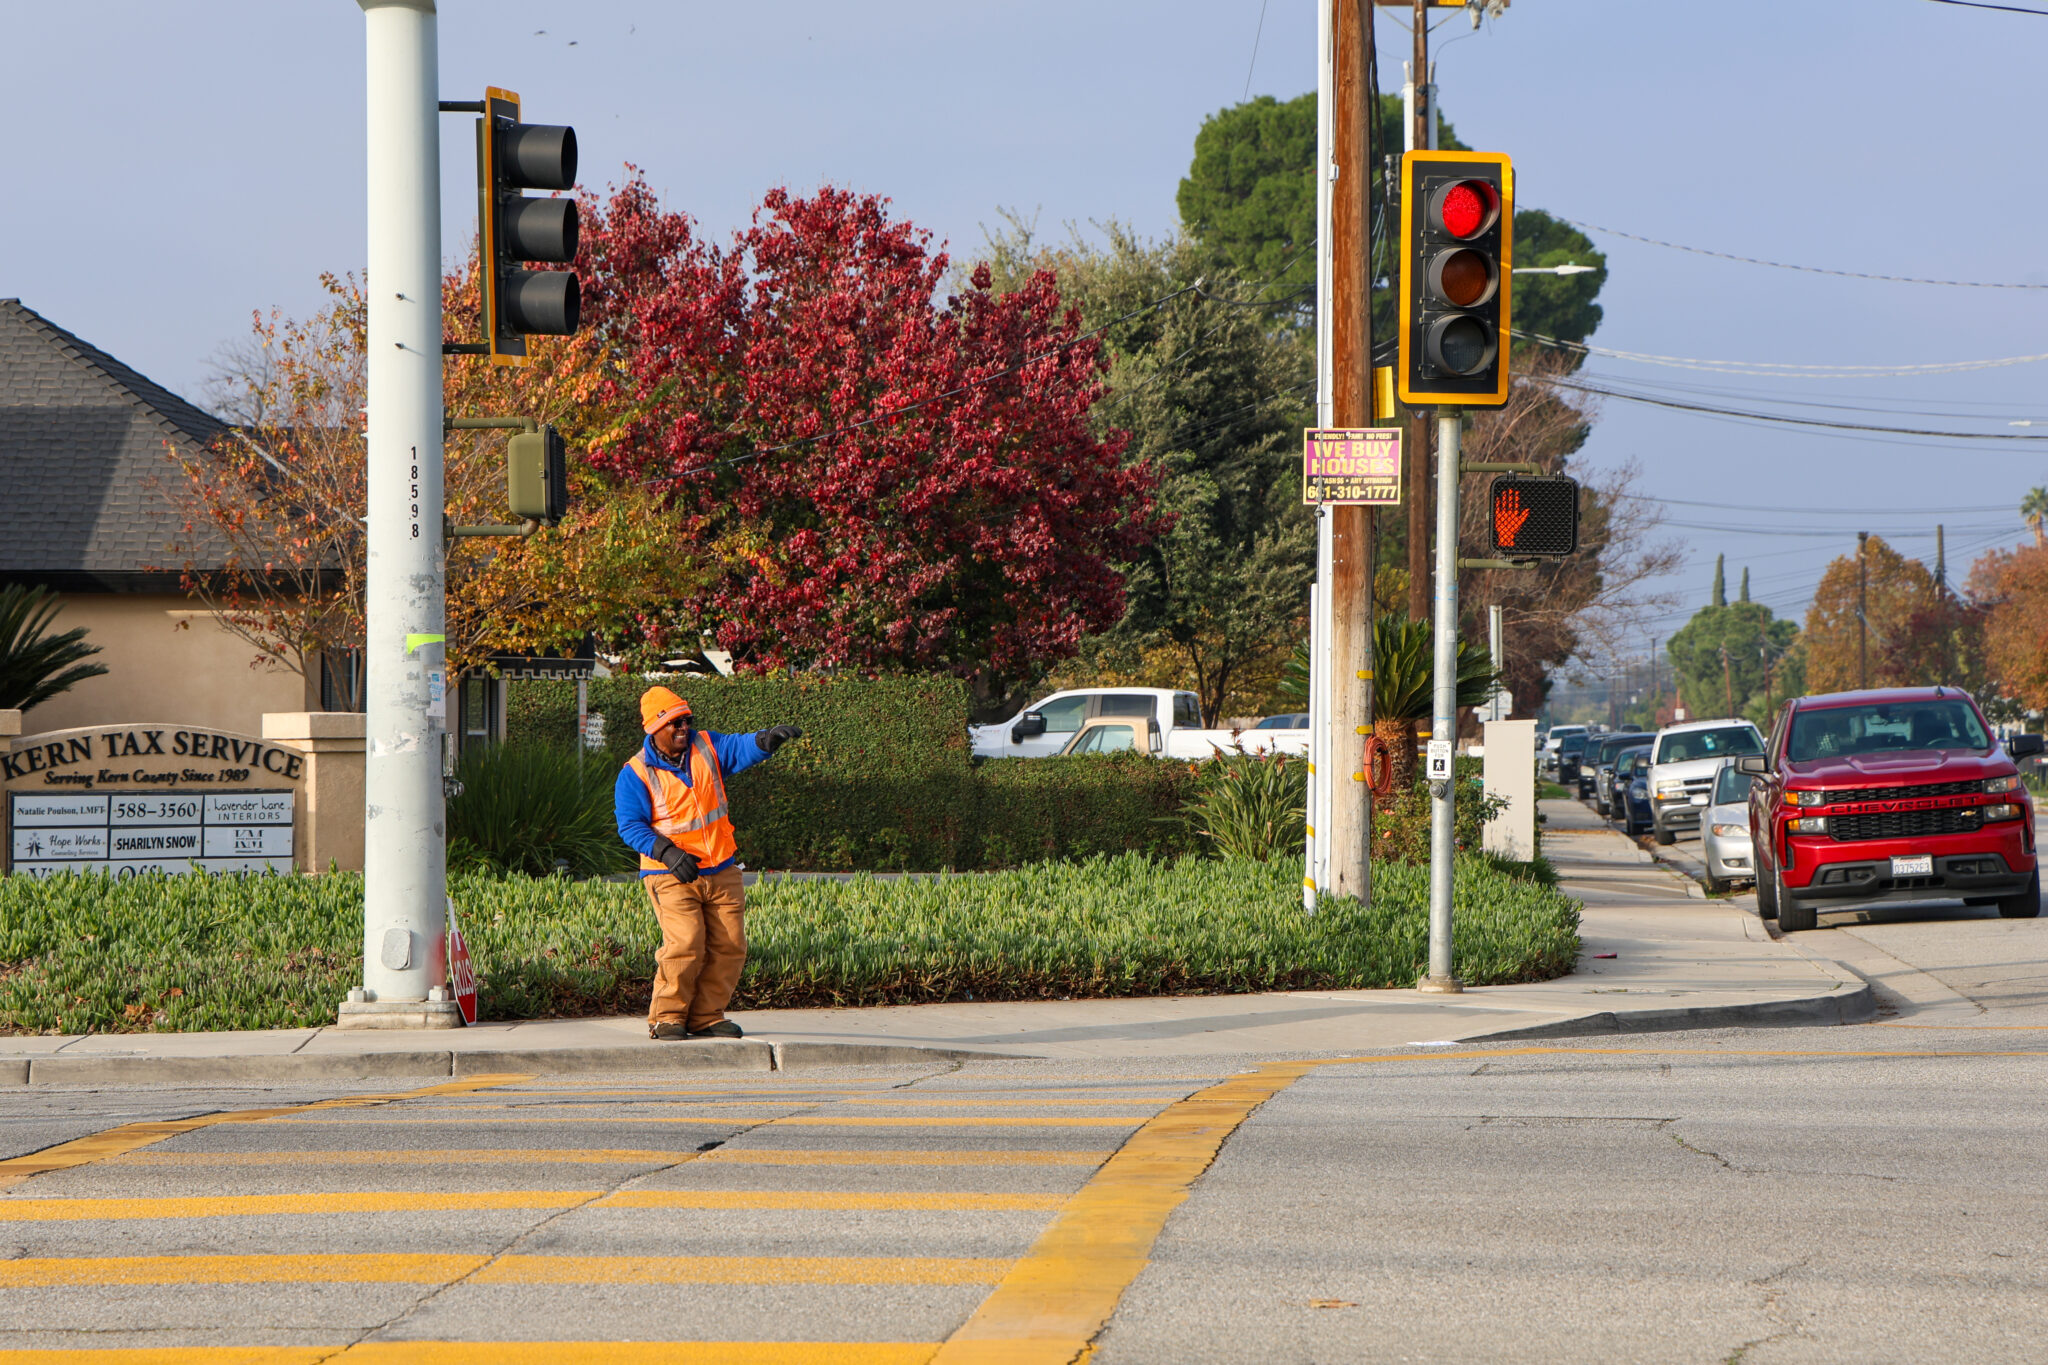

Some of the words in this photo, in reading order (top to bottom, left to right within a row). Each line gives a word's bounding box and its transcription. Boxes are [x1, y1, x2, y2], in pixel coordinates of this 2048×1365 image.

[1313, 441, 1347, 458] WE
[1351, 441, 1393, 458] BUY
[1311, 458, 1395, 475] HOUSES
[411, 446, 419, 537] 18598
[1, 735, 92, 781] KERN
[101, 730, 166, 758] TAX
[172, 730, 303, 781] SERVICE
[44, 770, 94, 788] Serving
[97, 769, 129, 783] Kern
[133, 769, 179, 786] County
[180, 768, 215, 783] Since
[217, 768, 250, 783] 1989
[19, 807, 45, 815] Natalie
[47, 806, 79, 816] Poulson,
[80, 806, 104, 814] LMFT
[116, 802, 196, 818] 588-3560
[214, 797, 259, 811] Lavender
[261, 796, 285, 810] Lane
[1830, 796, 1980, 814] CHEVROLET
[218, 811, 281, 821] INTERIORS
[49, 834, 72, 849] Hope
[75, 834, 102, 846] Works
[116, 836, 165, 850] SHARILYN
[166, 835, 196, 849] SNOW
